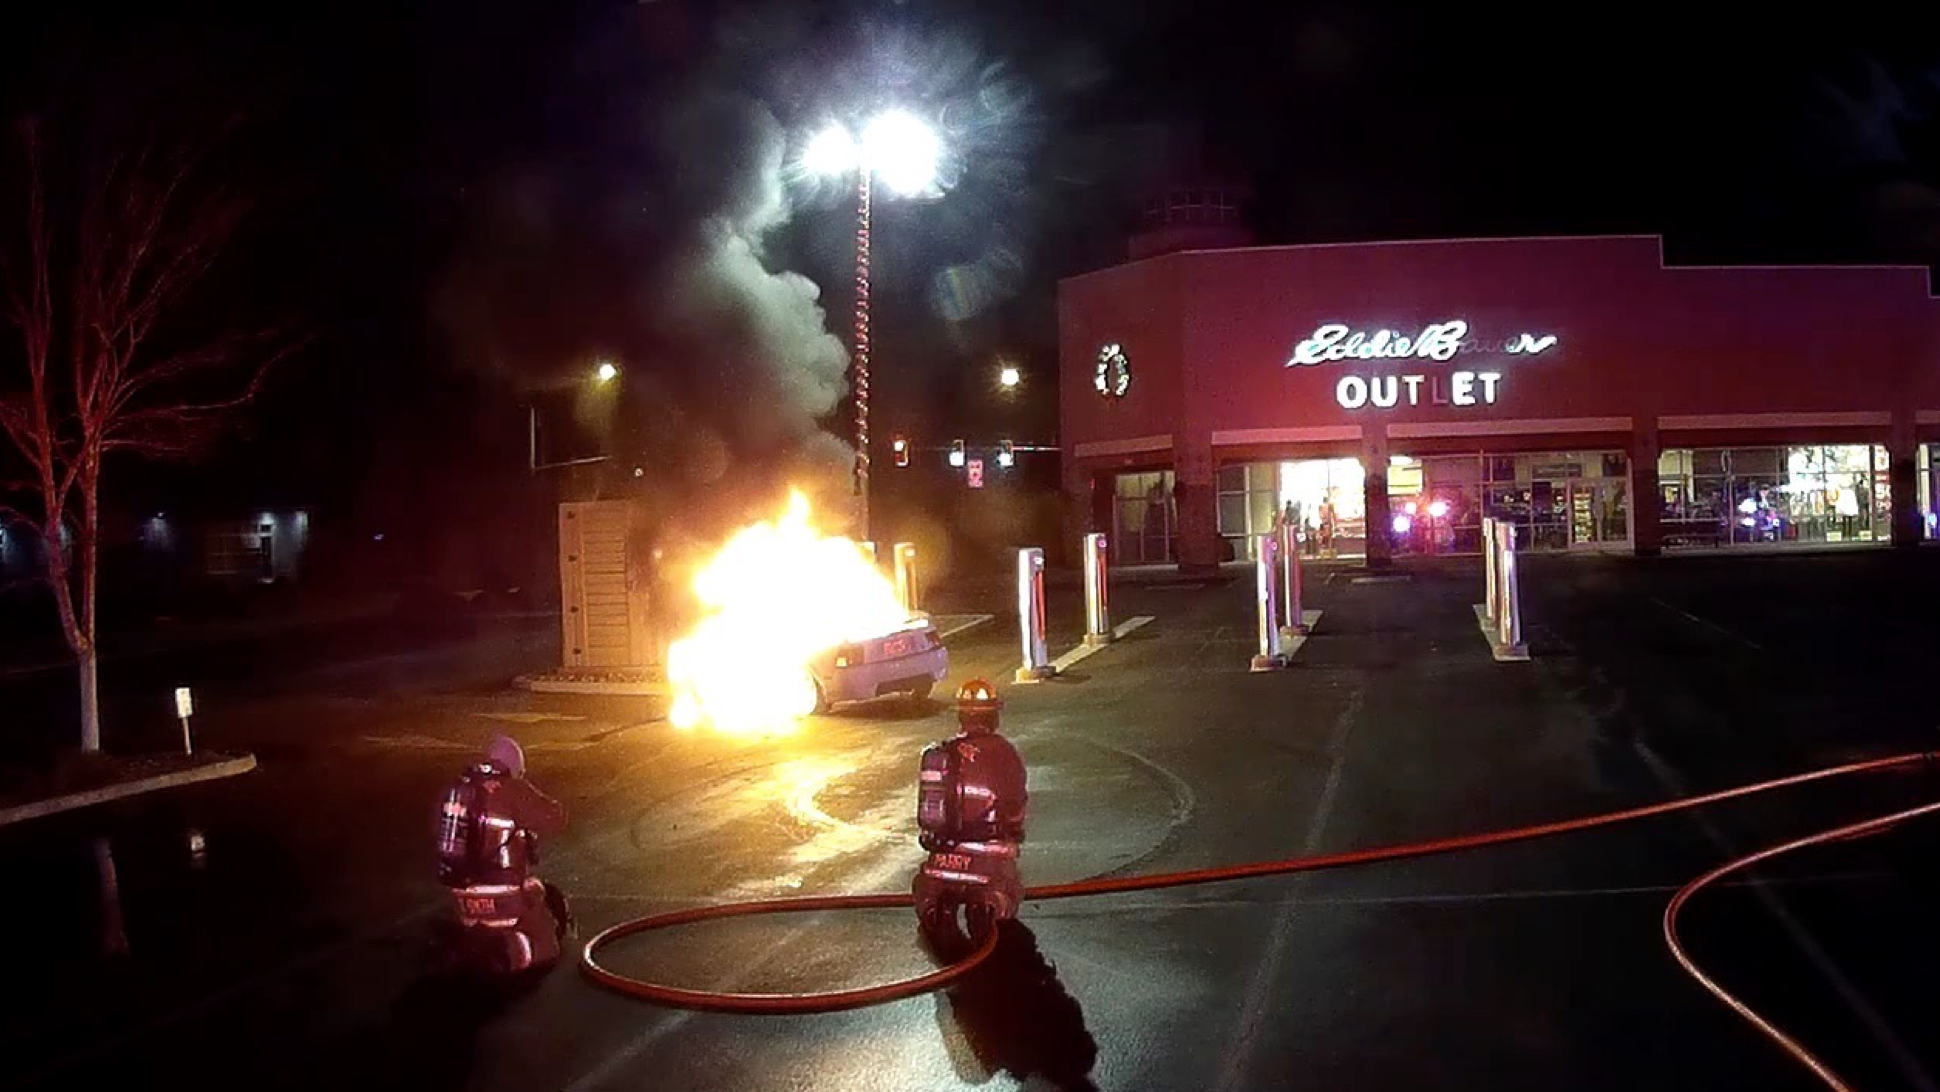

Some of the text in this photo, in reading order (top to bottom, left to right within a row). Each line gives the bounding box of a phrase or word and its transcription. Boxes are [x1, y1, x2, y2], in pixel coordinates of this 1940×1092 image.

[1285, 319, 1557, 367] Eddie Bauer
[1336, 368, 1503, 409] OUTLET
